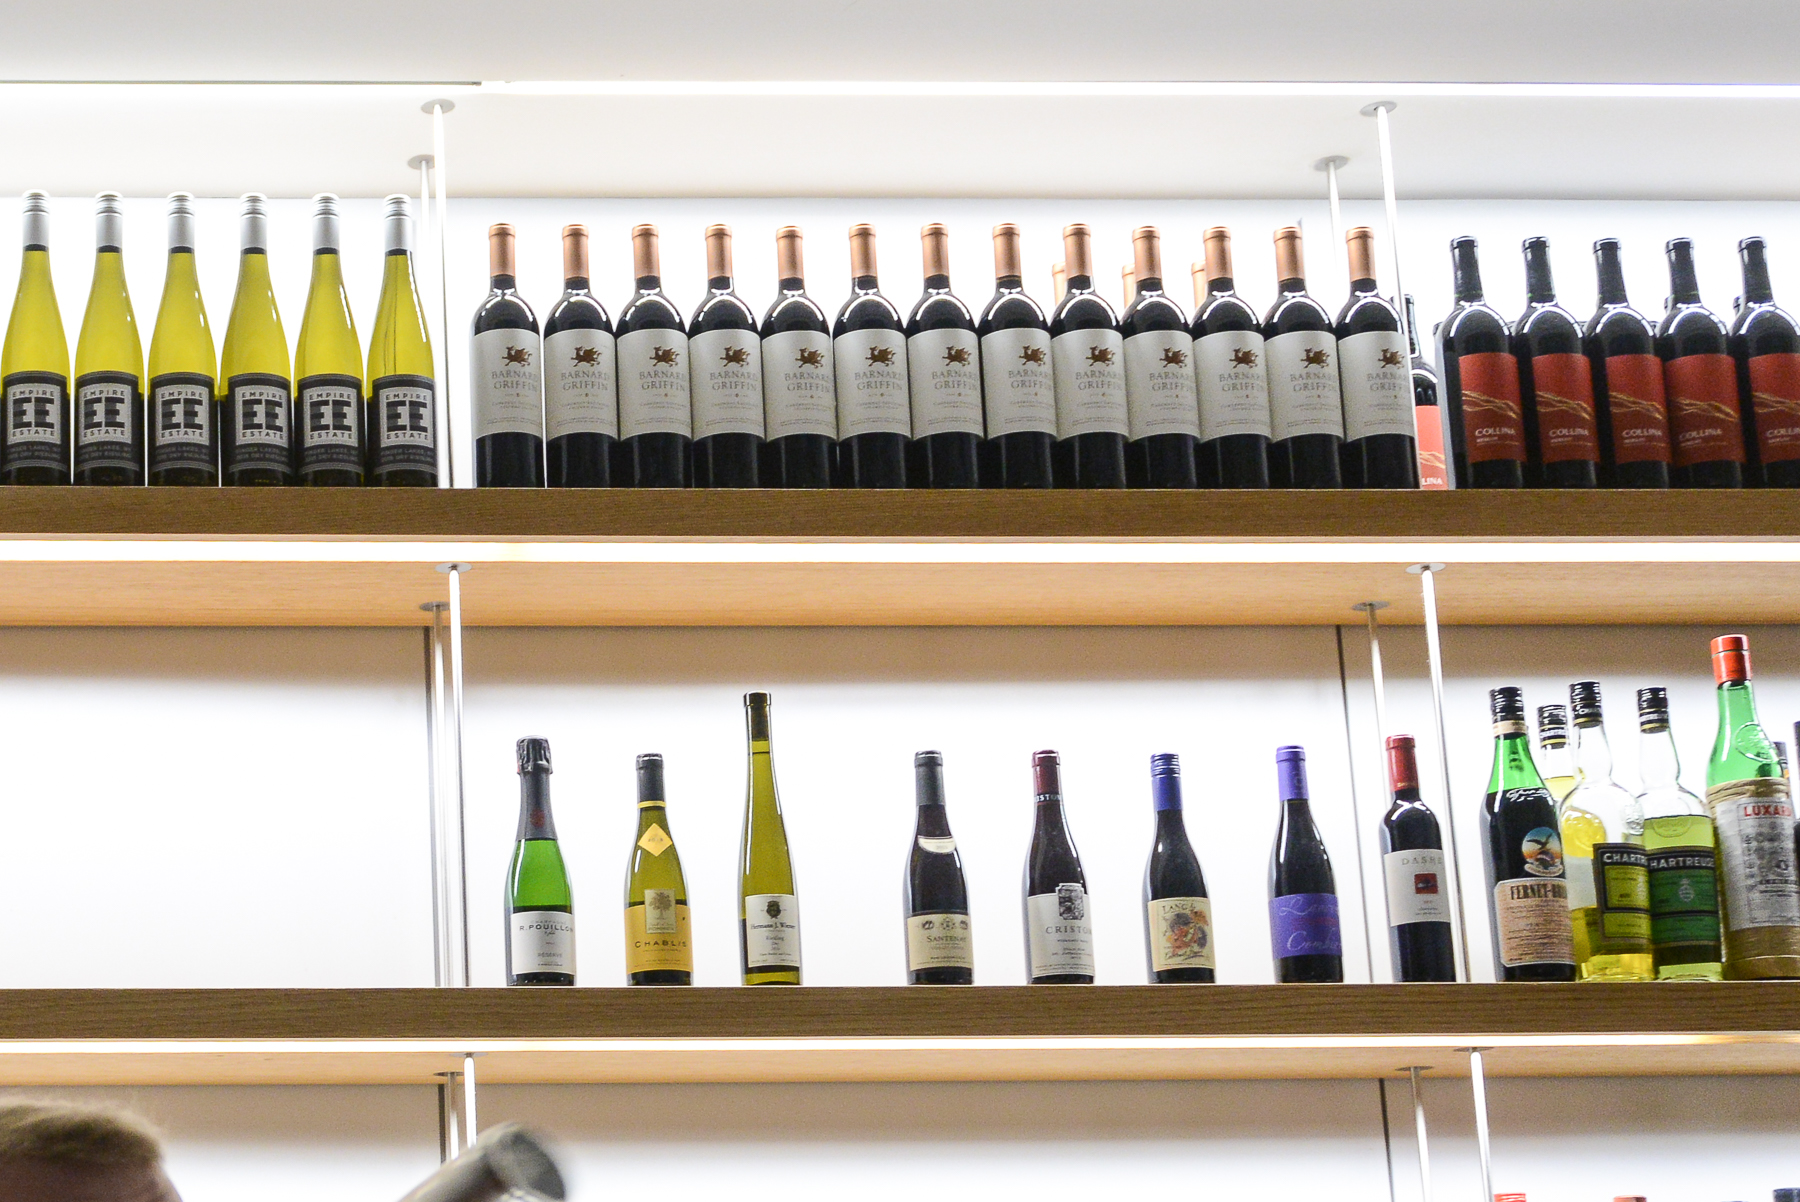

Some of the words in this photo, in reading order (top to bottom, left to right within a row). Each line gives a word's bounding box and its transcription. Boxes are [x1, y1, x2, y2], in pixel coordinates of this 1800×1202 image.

[12, 389, 54, 397] EMPIRE
[83, 389, 125, 398] EMPIRE
[161, 390, 203, 399] EMPIRE
[242, 391, 282, 400] EMPIRE
[310, 391, 352, 400] EMPIRE
[386, 391, 427, 401] EMPIRE
[12, 429, 55, 437] ESTATE
[83, 428, 125, 438] ESTATE
[161, 430, 204, 438] ESTATE
[242, 430, 283, 440] ESTATE
[310, 430, 352, 440] ESTATE
[386, 432, 428, 440] ESTATE
[1475, 428, 1516, 437] COLLINA
[1549, 428, 1589, 437] COLLINA
[1621, 429, 1662, 438] COLLINA
[1421, 477, 1443, 486] LINA
[1744, 805, 1792, 817] LUXARD
[1603, 853, 1649, 865] CHARTR
[634, 940, 687, 948] CHABLIS
